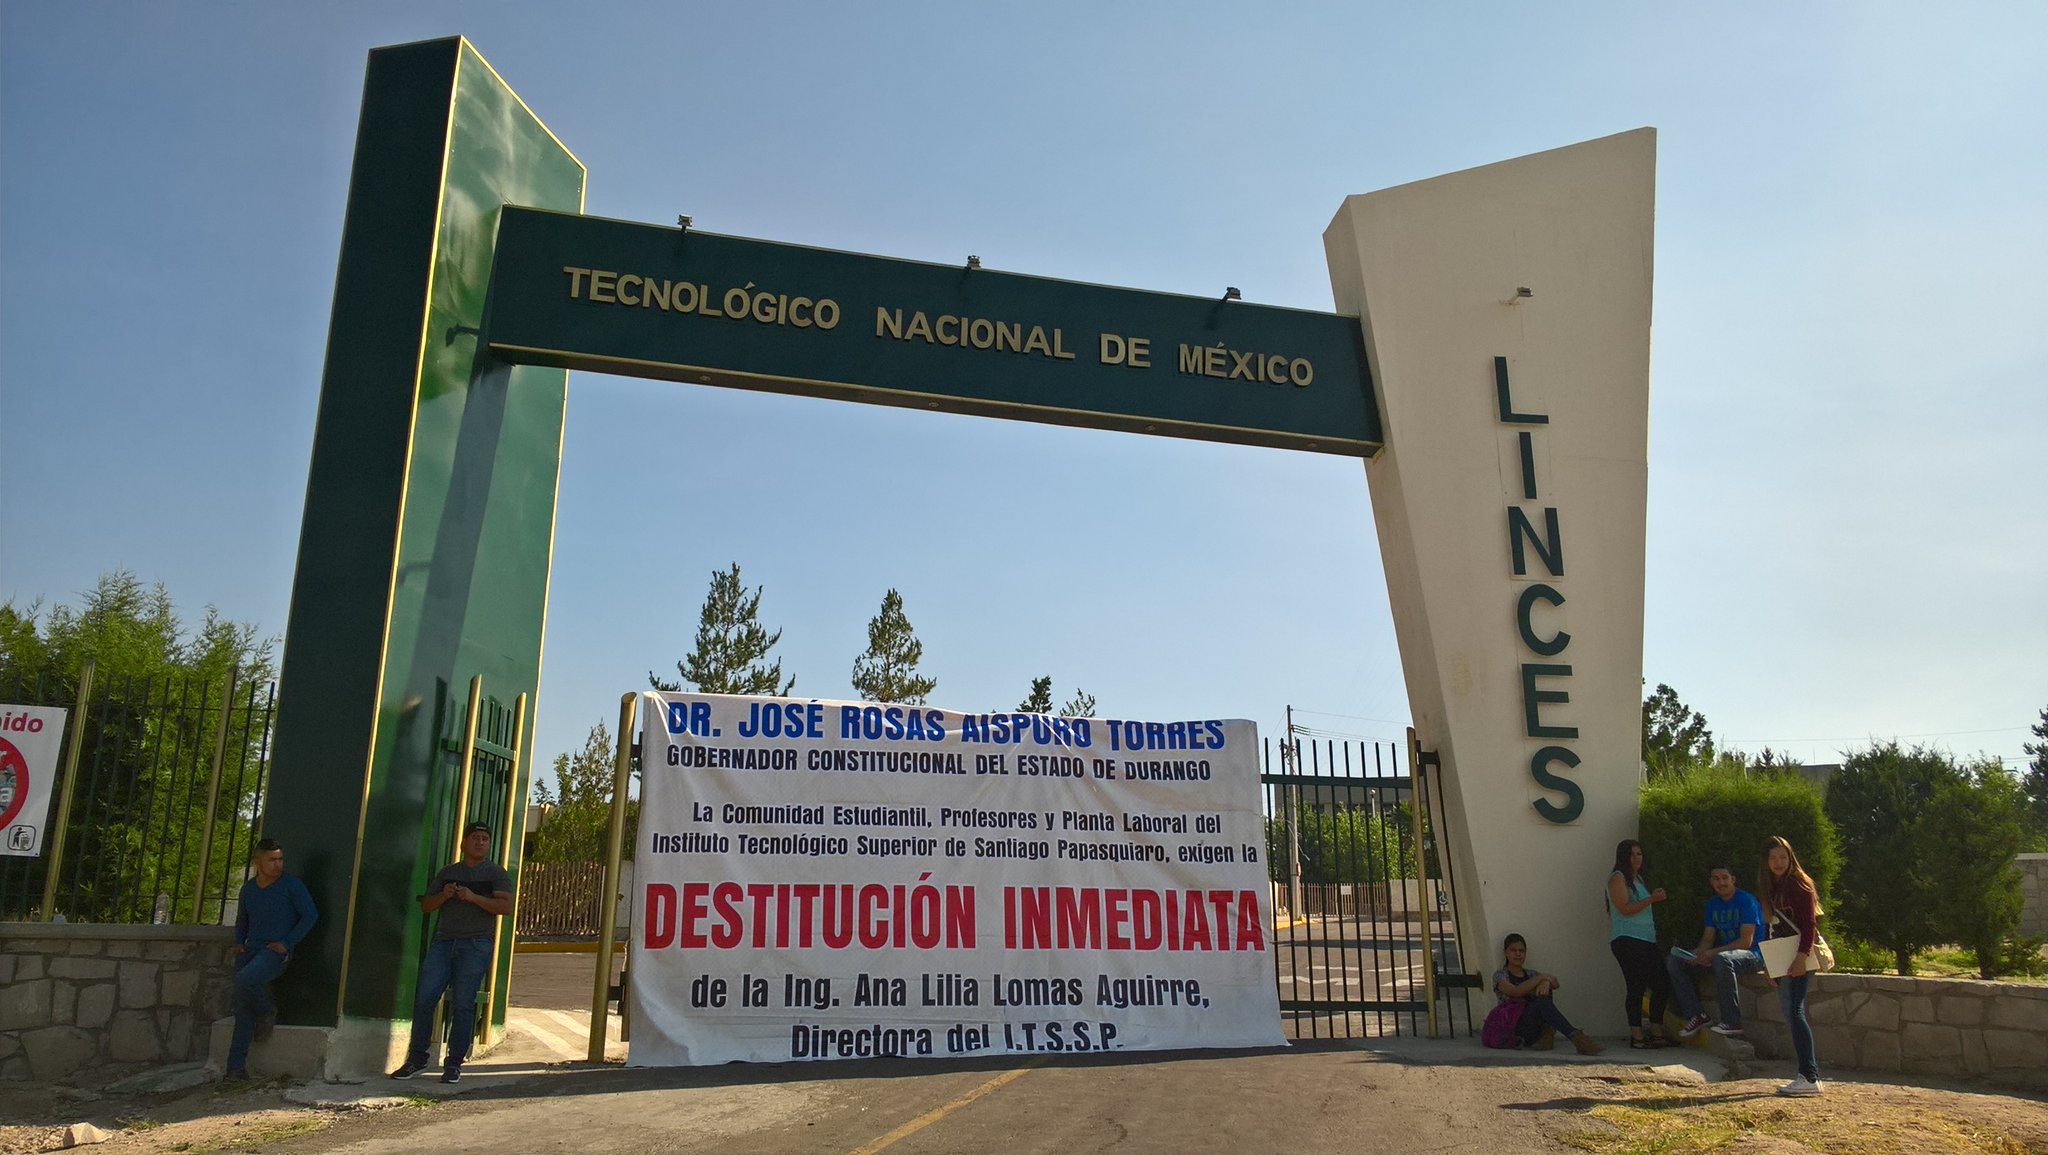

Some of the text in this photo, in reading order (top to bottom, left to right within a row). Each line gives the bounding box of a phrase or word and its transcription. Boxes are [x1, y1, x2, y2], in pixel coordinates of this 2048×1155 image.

[563, 266, 1314, 387] TECNOLÓGICO NACIONAL DE MÉXICO
[1493, 356, 1585, 824] LINCES
[0, 711, 44, 733] ido
[667, 699, 1226, 751] DR. JOSÉ ROSAS AISPURO TORRES
[666, 745, 1211, 781] GOBERNADOR CONSTITUCIONAL DEL ESTADO DE DURANGO
[693, 802, 1222, 834] La Comunidad Estudiantil, Profesores y Planta Laboral del
[652, 832, 730, 854] Instituto
[739, 832, 849, 857] Tecnológico
[857, 835, 938, 858] Superior
[944, 837, 966, 858] de
[974, 837, 1050, 860] Santiago
[1057, 840, 1170, 863] Papasquiaro,
[1242, 844, 1258, 863] la
[644, 872, 1266, 951] DESTITUCIÓN INMEDIATA
[691, 973, 1210, 1010] de la Ing. Ana Lilia Lomas Aguirre,
[791, 1024, 933, 1058] Directora
[947, 1024, 990, 1053] del
